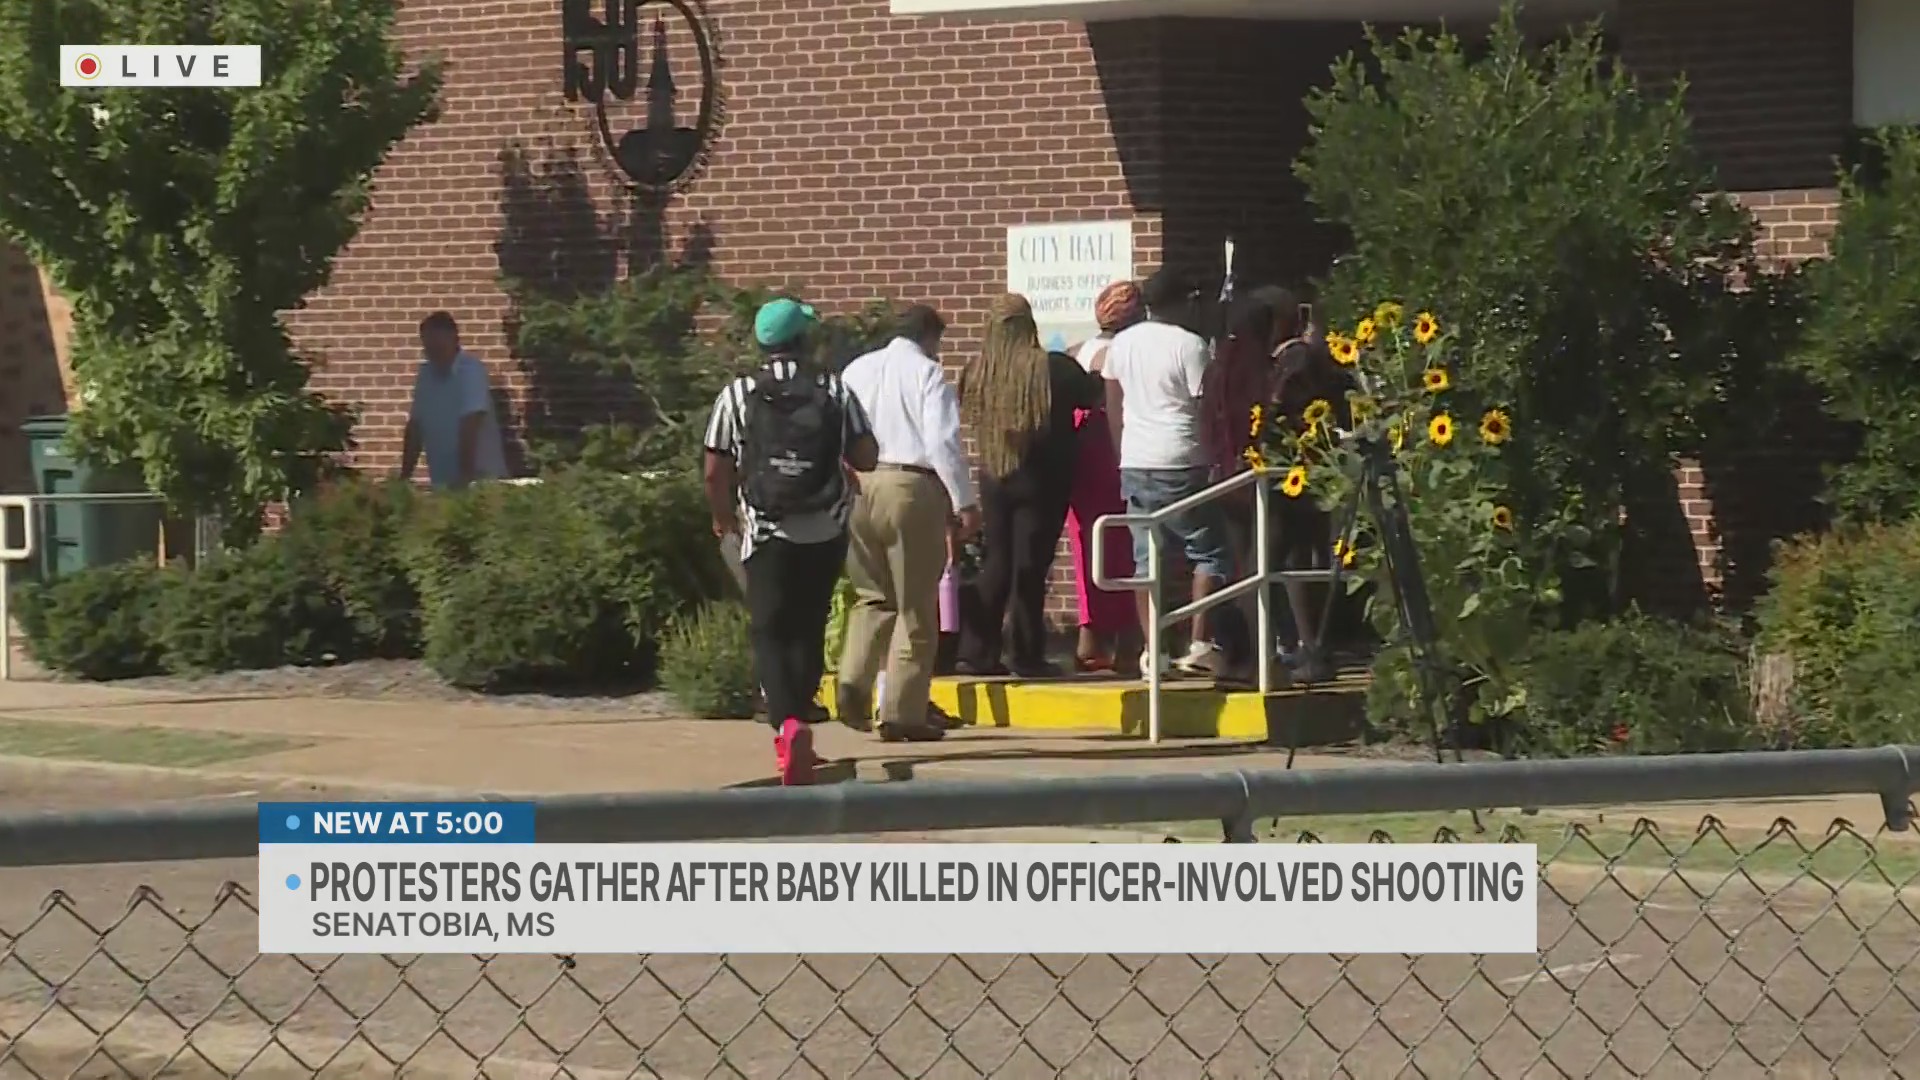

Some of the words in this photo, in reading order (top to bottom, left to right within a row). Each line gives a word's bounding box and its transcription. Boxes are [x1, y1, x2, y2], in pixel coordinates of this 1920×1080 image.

[1019, 236, 1059, 262] CITY
[1070, 232, 1116, 261] HALL
[1027, 274, 1073, 291] BUSINESS
